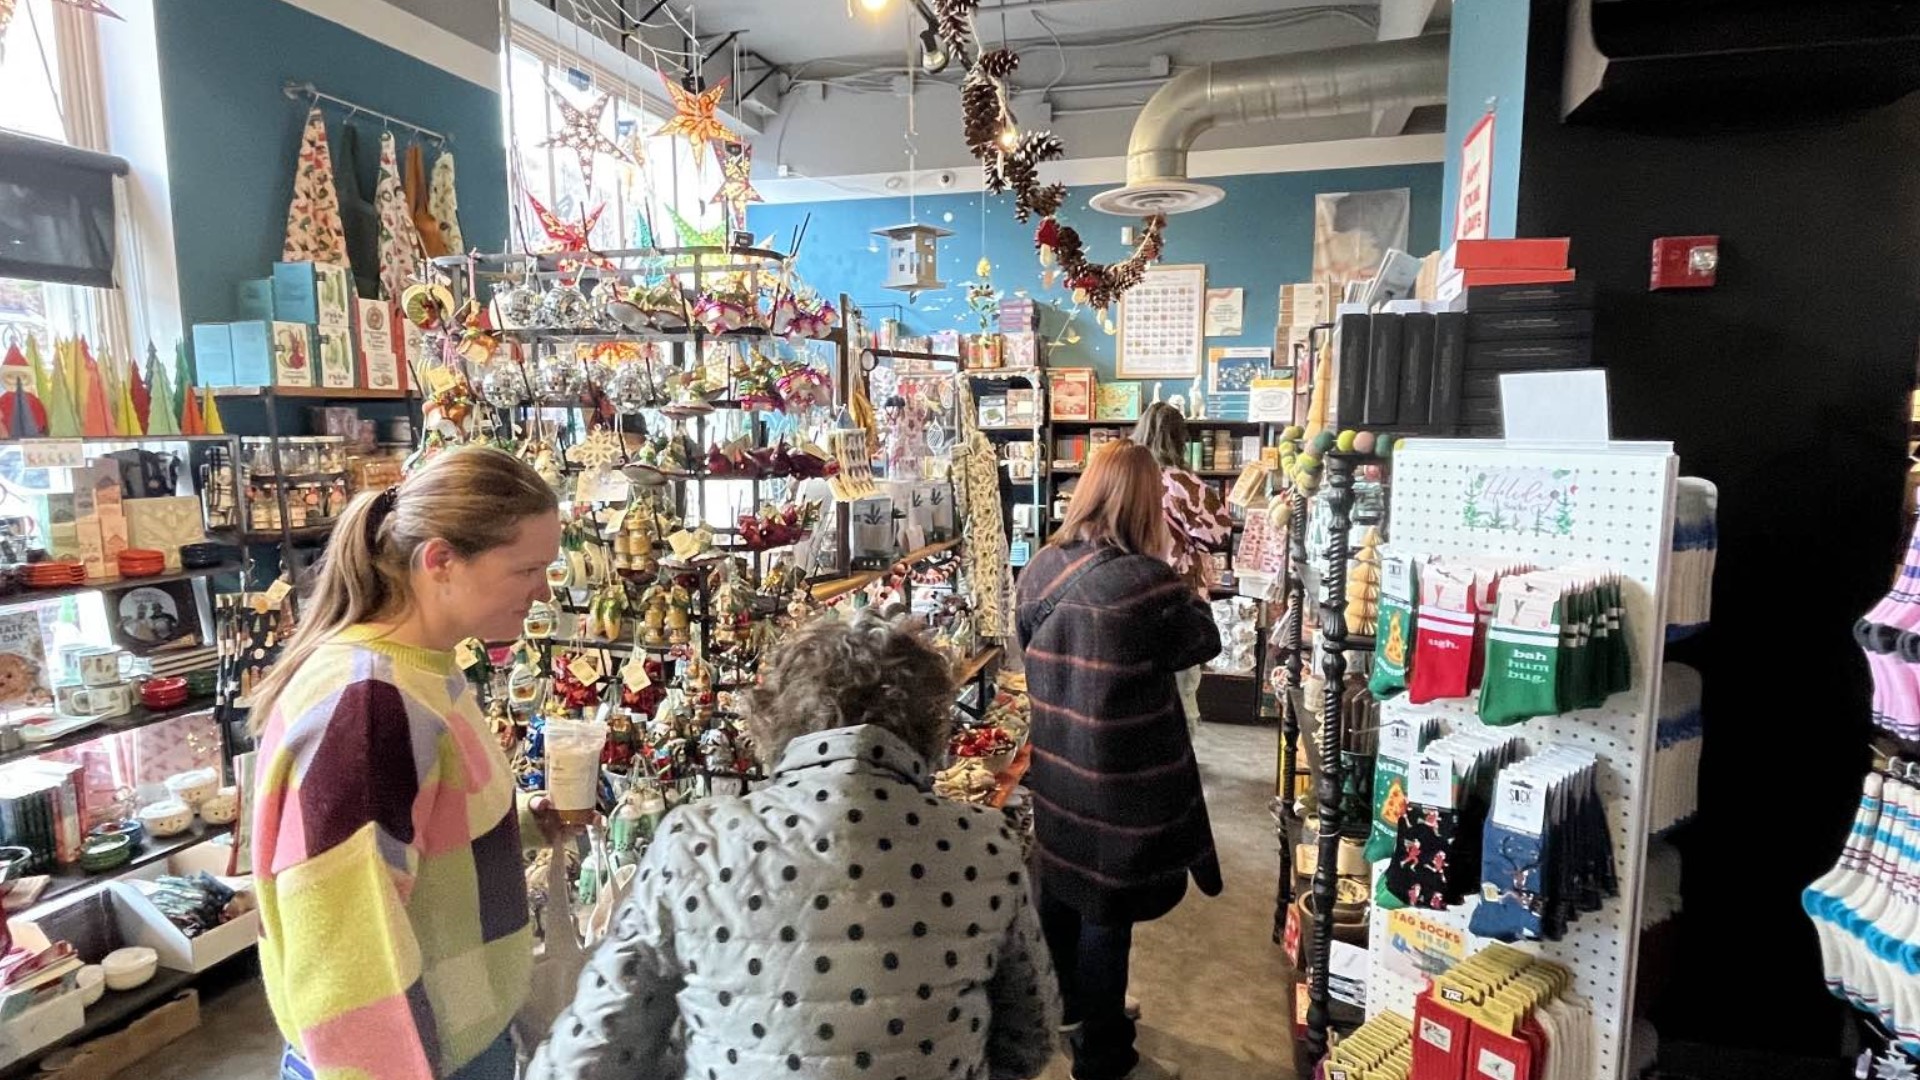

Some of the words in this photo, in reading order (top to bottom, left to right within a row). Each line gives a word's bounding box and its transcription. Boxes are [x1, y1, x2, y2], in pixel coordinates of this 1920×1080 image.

[1428, 637, 1460, 650] ugh.
[1513, 648, 1547, 661] bah
[1508, 659, 1549, 672] hum
[1508, 669, 1546, 684] bug.
[1392, 911, 1416, 926] TAG
[1419, 921, 1461, 944] SOCKS
